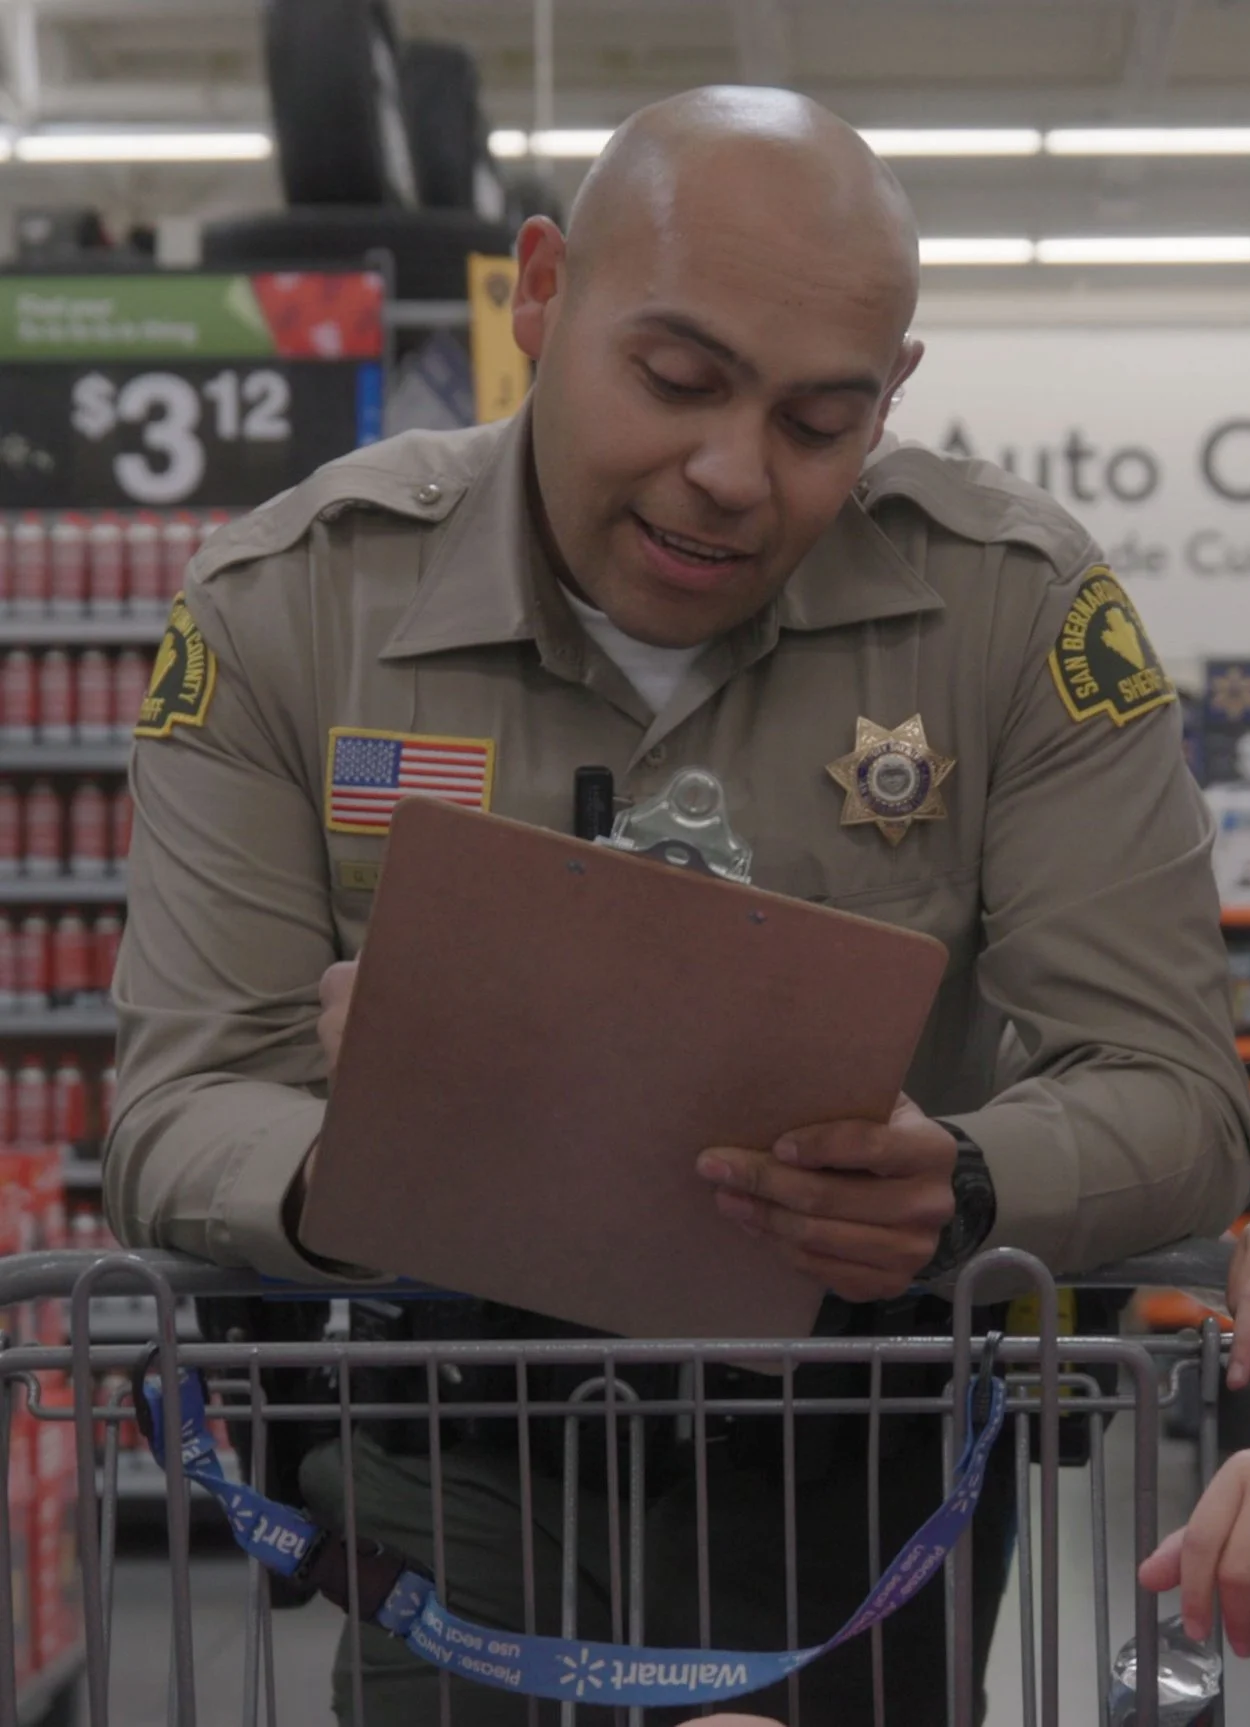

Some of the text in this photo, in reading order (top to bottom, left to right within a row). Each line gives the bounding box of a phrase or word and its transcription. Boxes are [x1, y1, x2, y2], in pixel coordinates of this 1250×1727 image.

[1063, 655, 1099, 699] SAN
[446, 1626, 482, 1651] seat
[488, 1640, 521, 1658] use
[458, 1655, 522, 1686] Please:
[612, 1659, 747, 1689] Walmart
